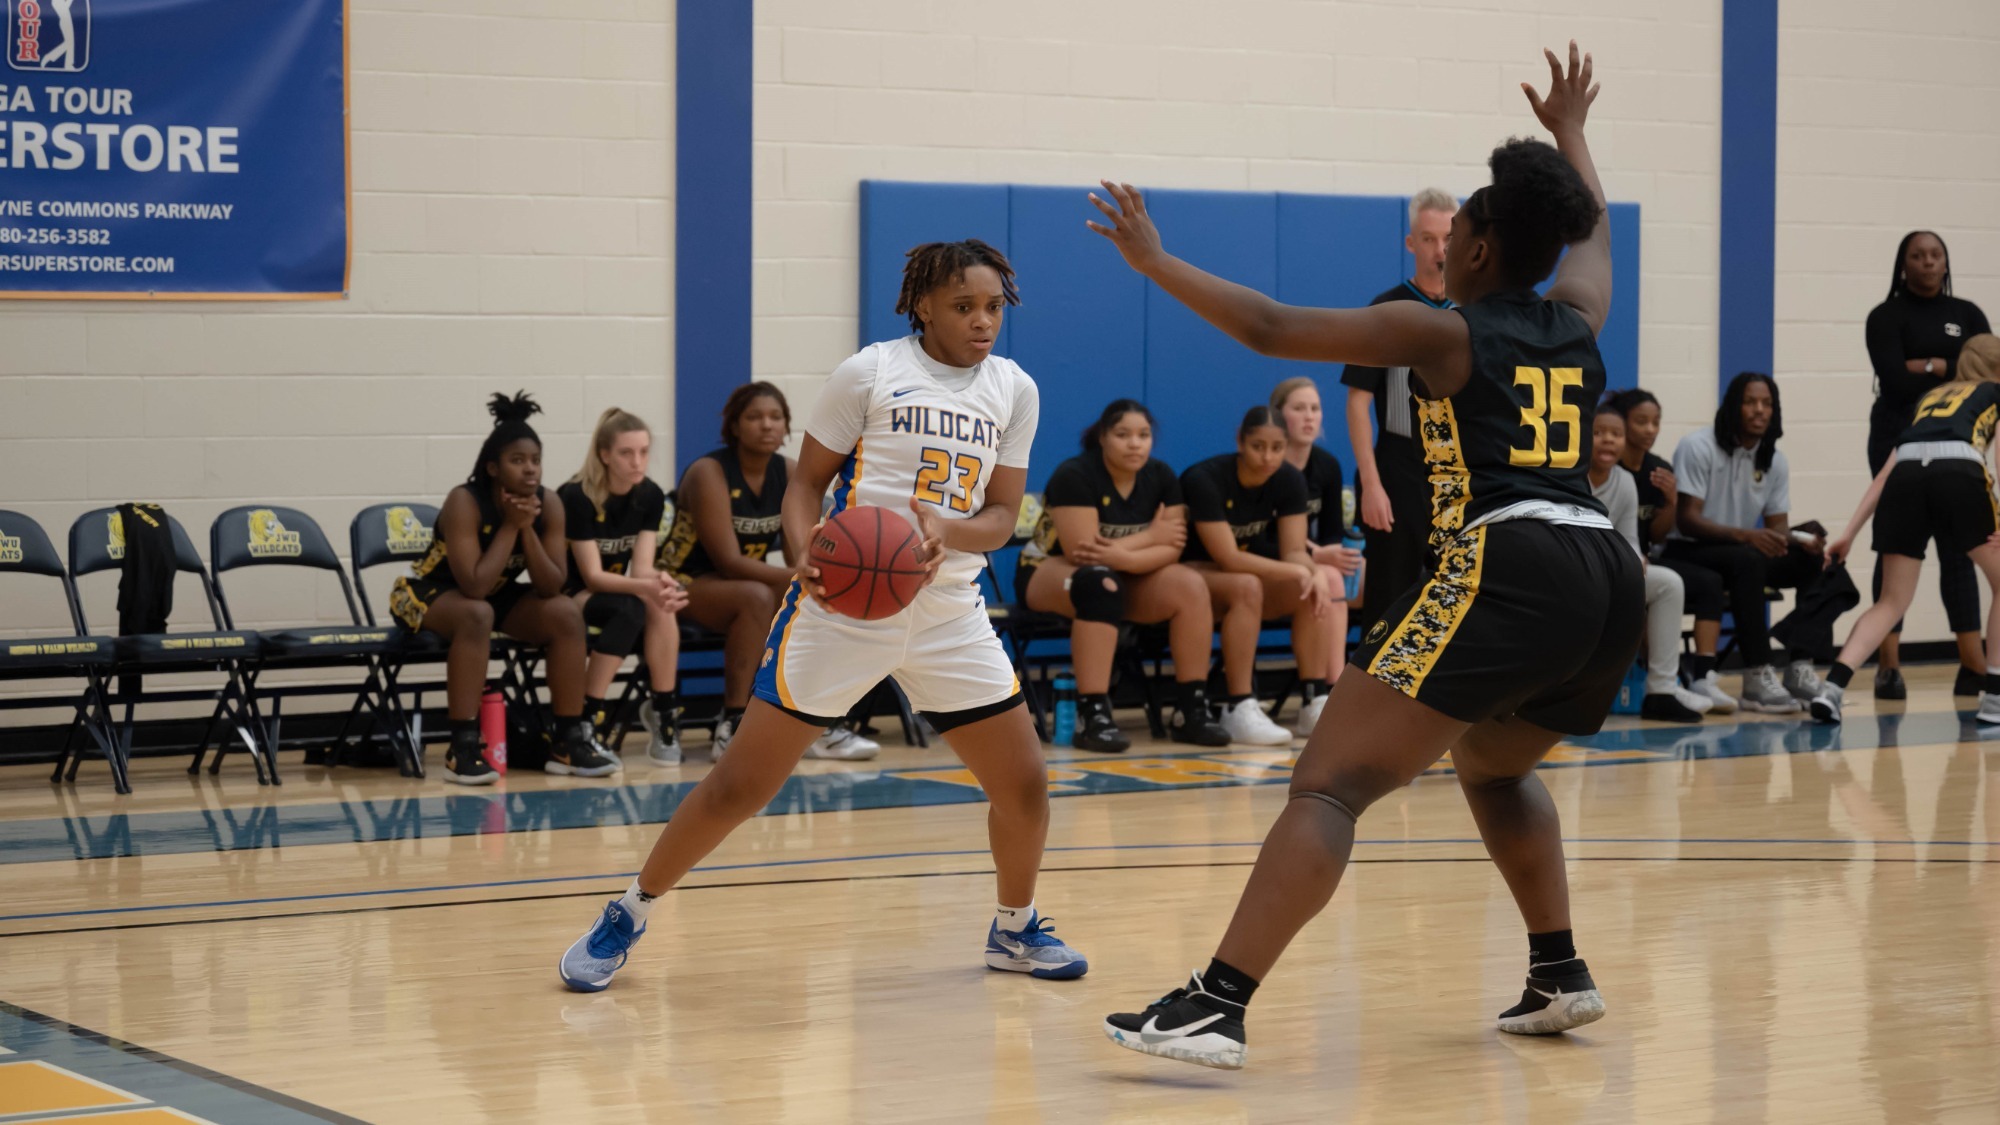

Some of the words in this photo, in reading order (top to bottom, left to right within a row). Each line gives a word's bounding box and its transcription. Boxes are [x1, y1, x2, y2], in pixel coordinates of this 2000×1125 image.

[46, 86, 133, 115] TOUR
[0, 121, 239, 173] RSTORE
[38, 201, 139, 219] COMMONS
[145, 203, 234, 220] PARKWAY
[1509, 365, 1584, 469] 35
[913, 446, 983, 514] 23
[250, 543, 300, 555] WILDCATS
